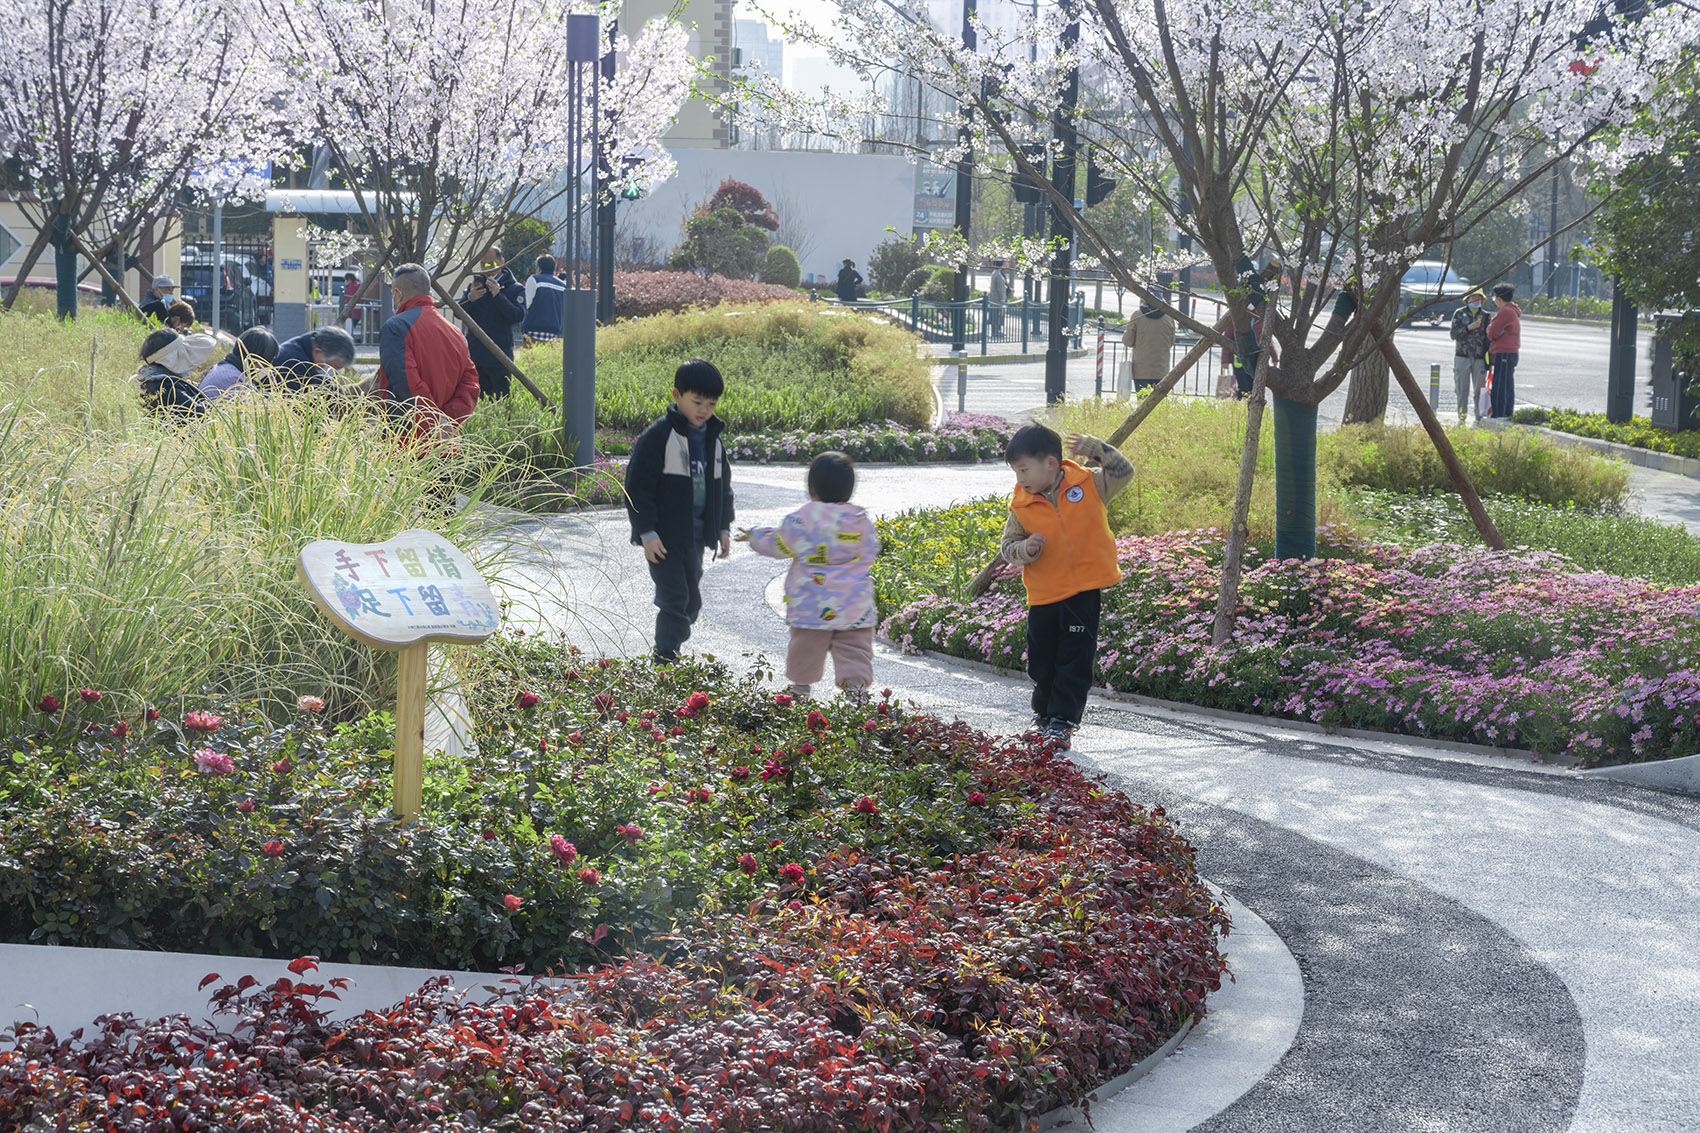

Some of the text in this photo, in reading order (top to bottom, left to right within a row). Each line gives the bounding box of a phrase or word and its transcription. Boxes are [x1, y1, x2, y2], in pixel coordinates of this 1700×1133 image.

[334, 544, 462, 582] 手下留情
[1069, 625, 1085, 633] 1977
